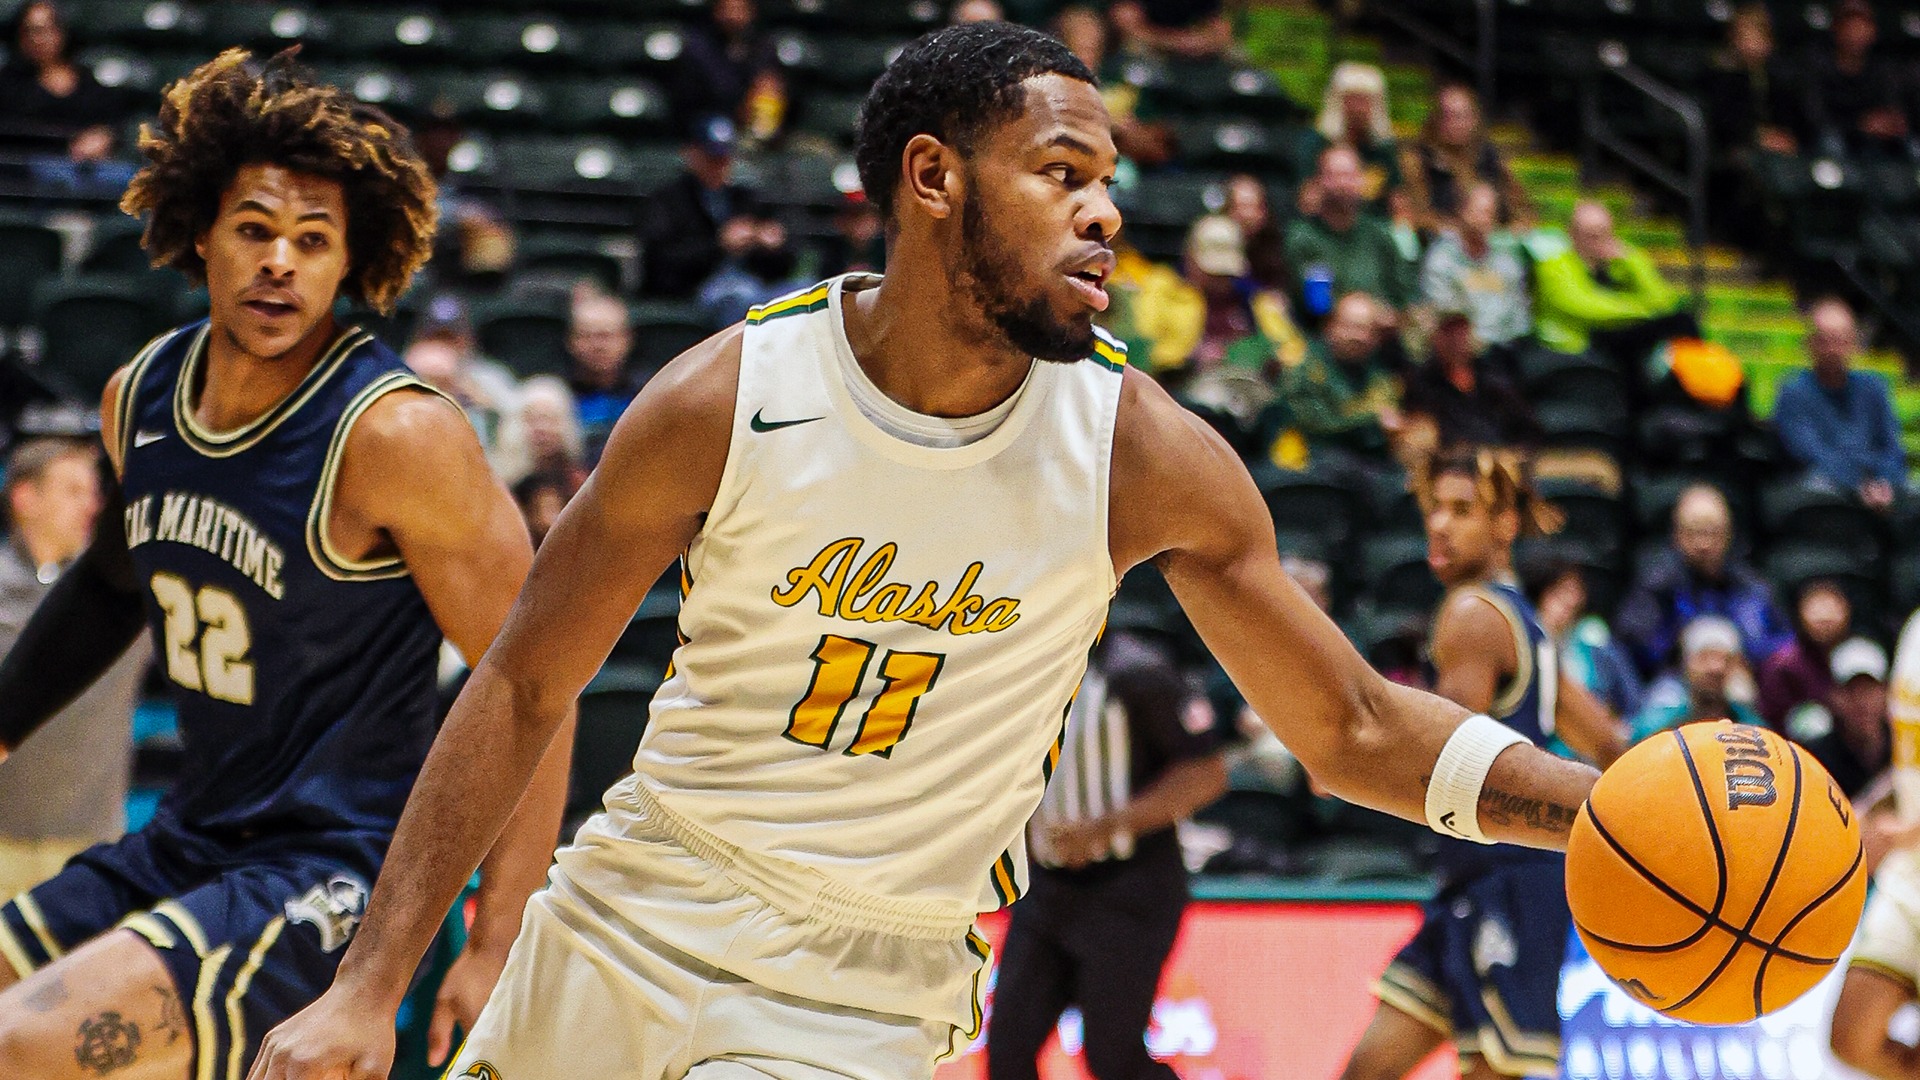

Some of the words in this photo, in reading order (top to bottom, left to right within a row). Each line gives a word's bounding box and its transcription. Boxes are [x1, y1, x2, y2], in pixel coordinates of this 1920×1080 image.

[156, 492, 285, 600] MARITIME
[770, 537, 1021, 635] Alaska
[150, 571, 254, 706] 22
[780, 634, 947, 760] 11
